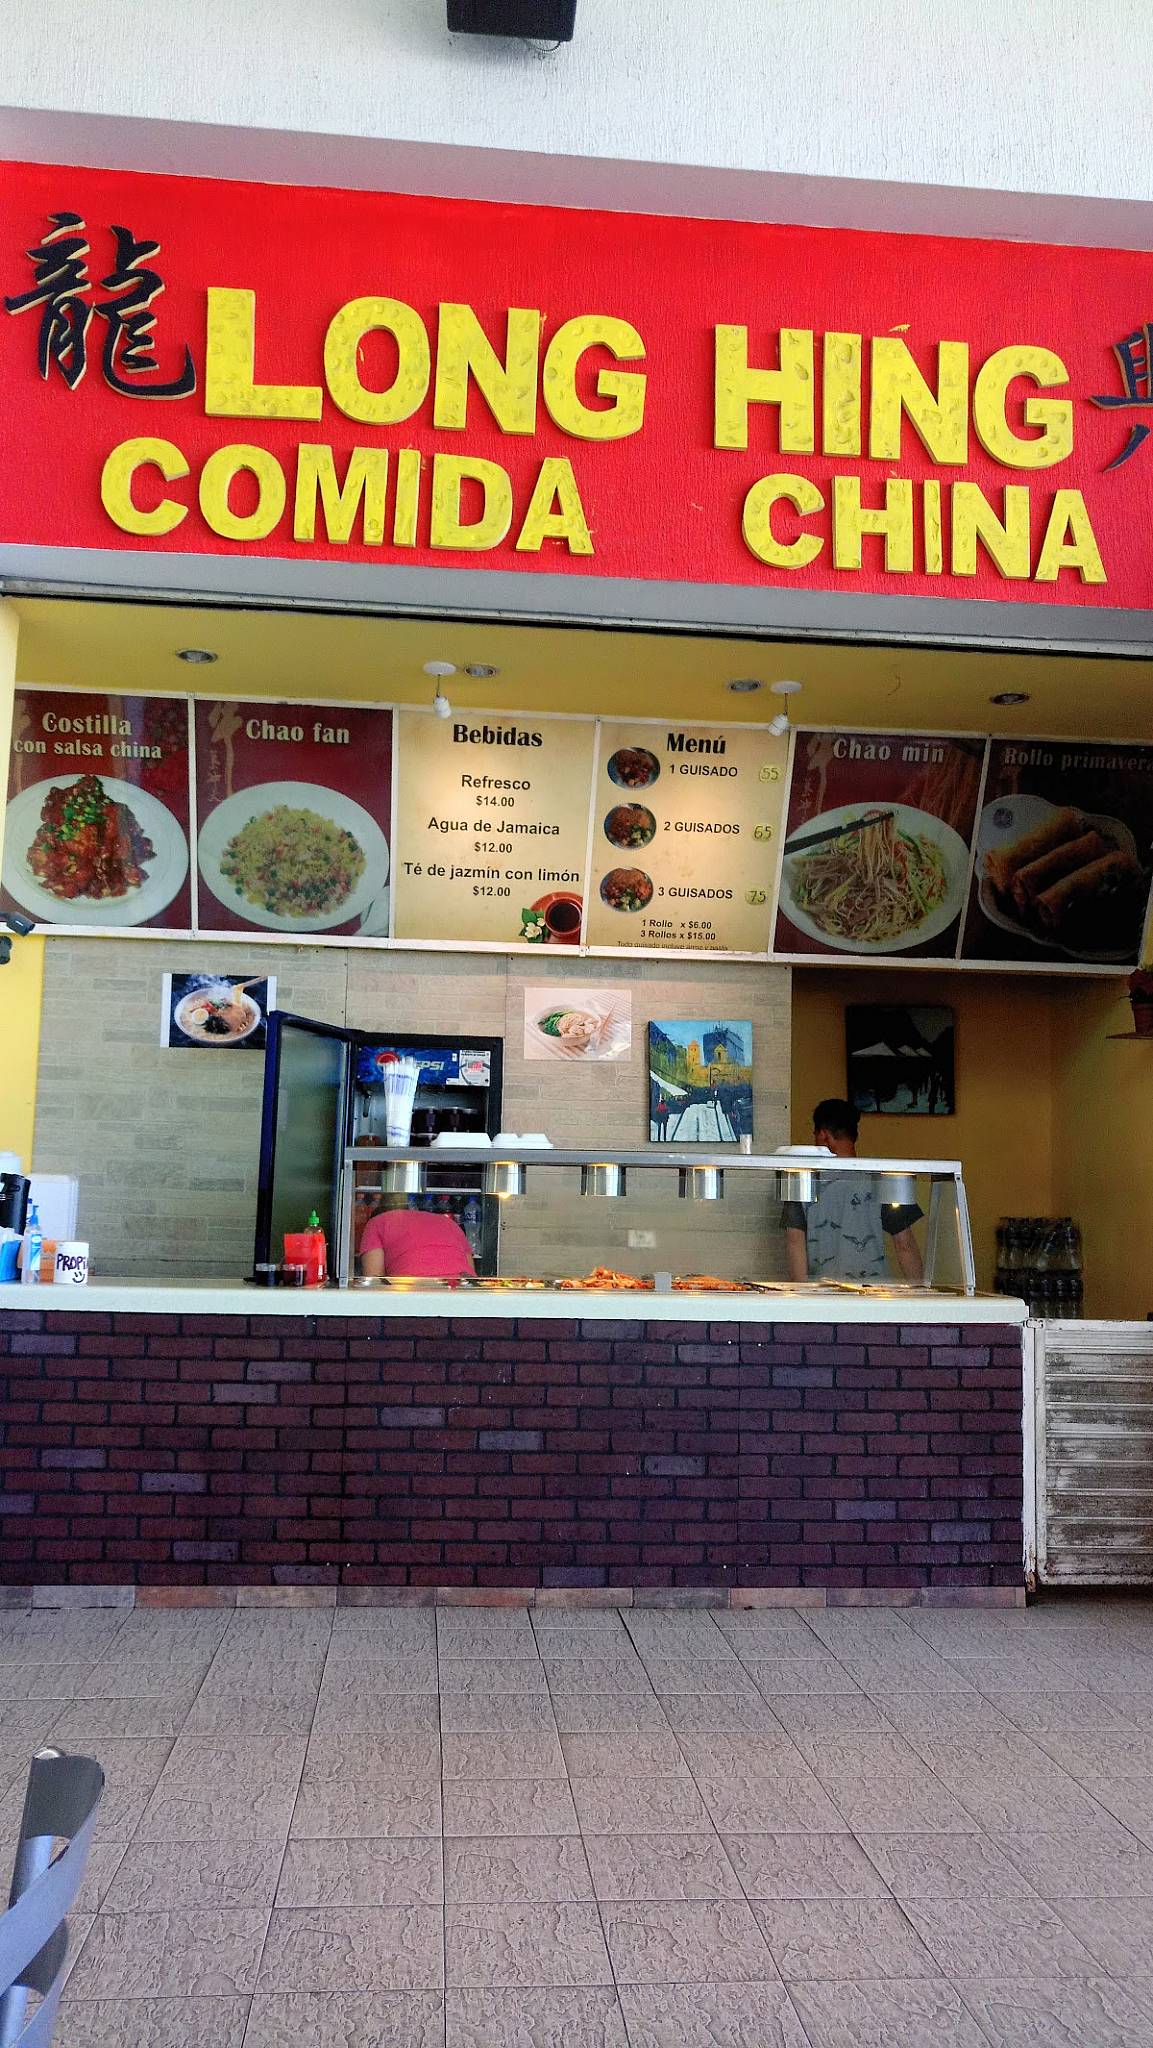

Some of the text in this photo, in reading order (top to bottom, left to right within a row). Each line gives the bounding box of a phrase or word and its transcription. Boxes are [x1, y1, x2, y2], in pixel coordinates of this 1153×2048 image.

[4, 212, 196, 401] 龍
[205, 287, 648, 441] LONG
[713, 323, 1074, 470] HING
[101, 437, 1108, 584] COMIDA CHINA
[42, 712, 133, 737] Costilla
[246, 719, 350, 744] Chao fan
[453, 724, 543, 747] Bebidas
[667, 733, 727, 754] Menú
[13, 738, 162, 760] con salsa china
[833, 739, 945, 763] Chao min
[1004, 747, 1054, 766] Rollo
[669, 765, 738, 777] 1 GUISADO
[760, 767, 780, 780] 55
[461, 775, 531, 791] Refresco
[475, 795, 515, 807] $14.00
[428, 817, 560, 835] Agua de Jamaica
[664, 821, 740, 834] 2 GUISADOS
[753, 826, 772, 841] 65
[474, 842, 513, 853] $12.00
[404, 862, 580, 882] Té de jazmín con limón
[472, 886, 511, 897] $12.00
[658, 887, 733, 899] 3 GUISADOS
[749, 890, 767, 903] 75
[649, 919, 673, 928] Rollo
[688, 921, 712, 929] $6.00
[648, 930, 677, 939] Rollos
[687, 932, 716, 940] $15.00
